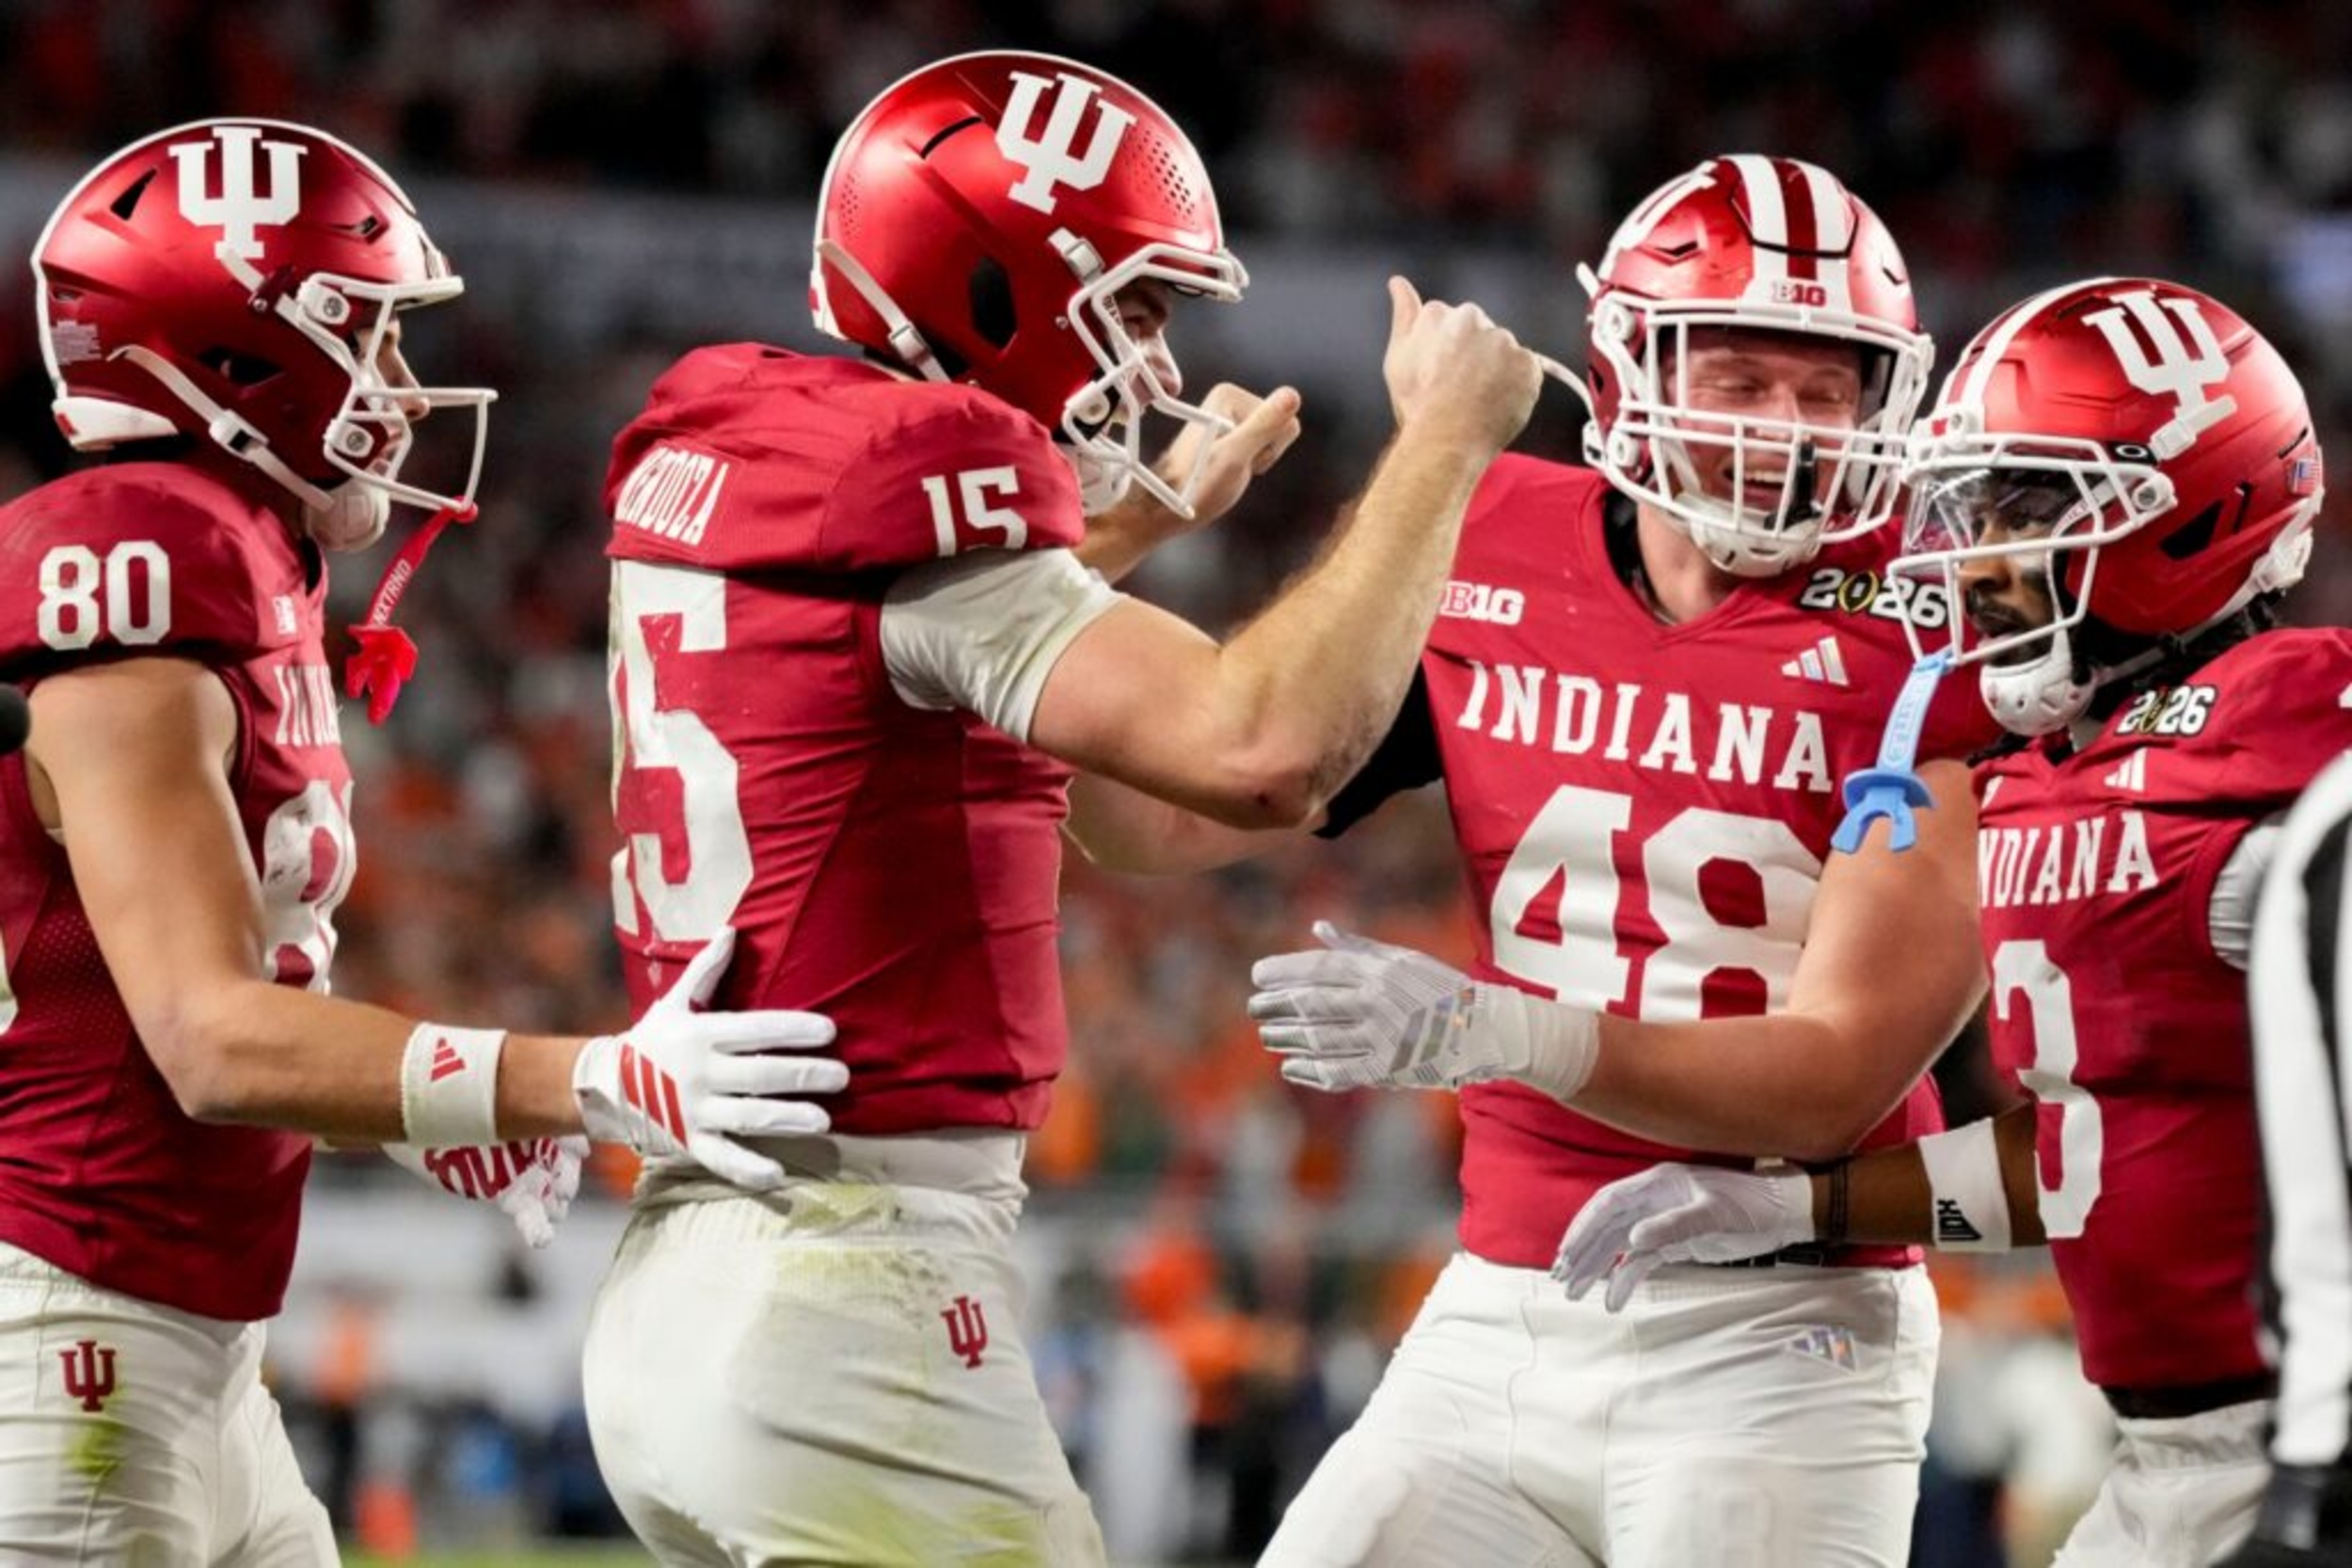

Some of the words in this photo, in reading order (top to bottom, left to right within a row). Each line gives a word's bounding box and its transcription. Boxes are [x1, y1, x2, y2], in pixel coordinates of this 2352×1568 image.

[922, 467, 1028, 557] 15
[38, 539, 171, 651] 80
[1457, 659, 1835, 793] INDIANA
[2114, 684, 2217, 736] 2026
[1490, 784, 1823, 1023] 48
[1977, 810, 2161, 910] NDIANA
[1992, 938, 2103, 1240] 3
